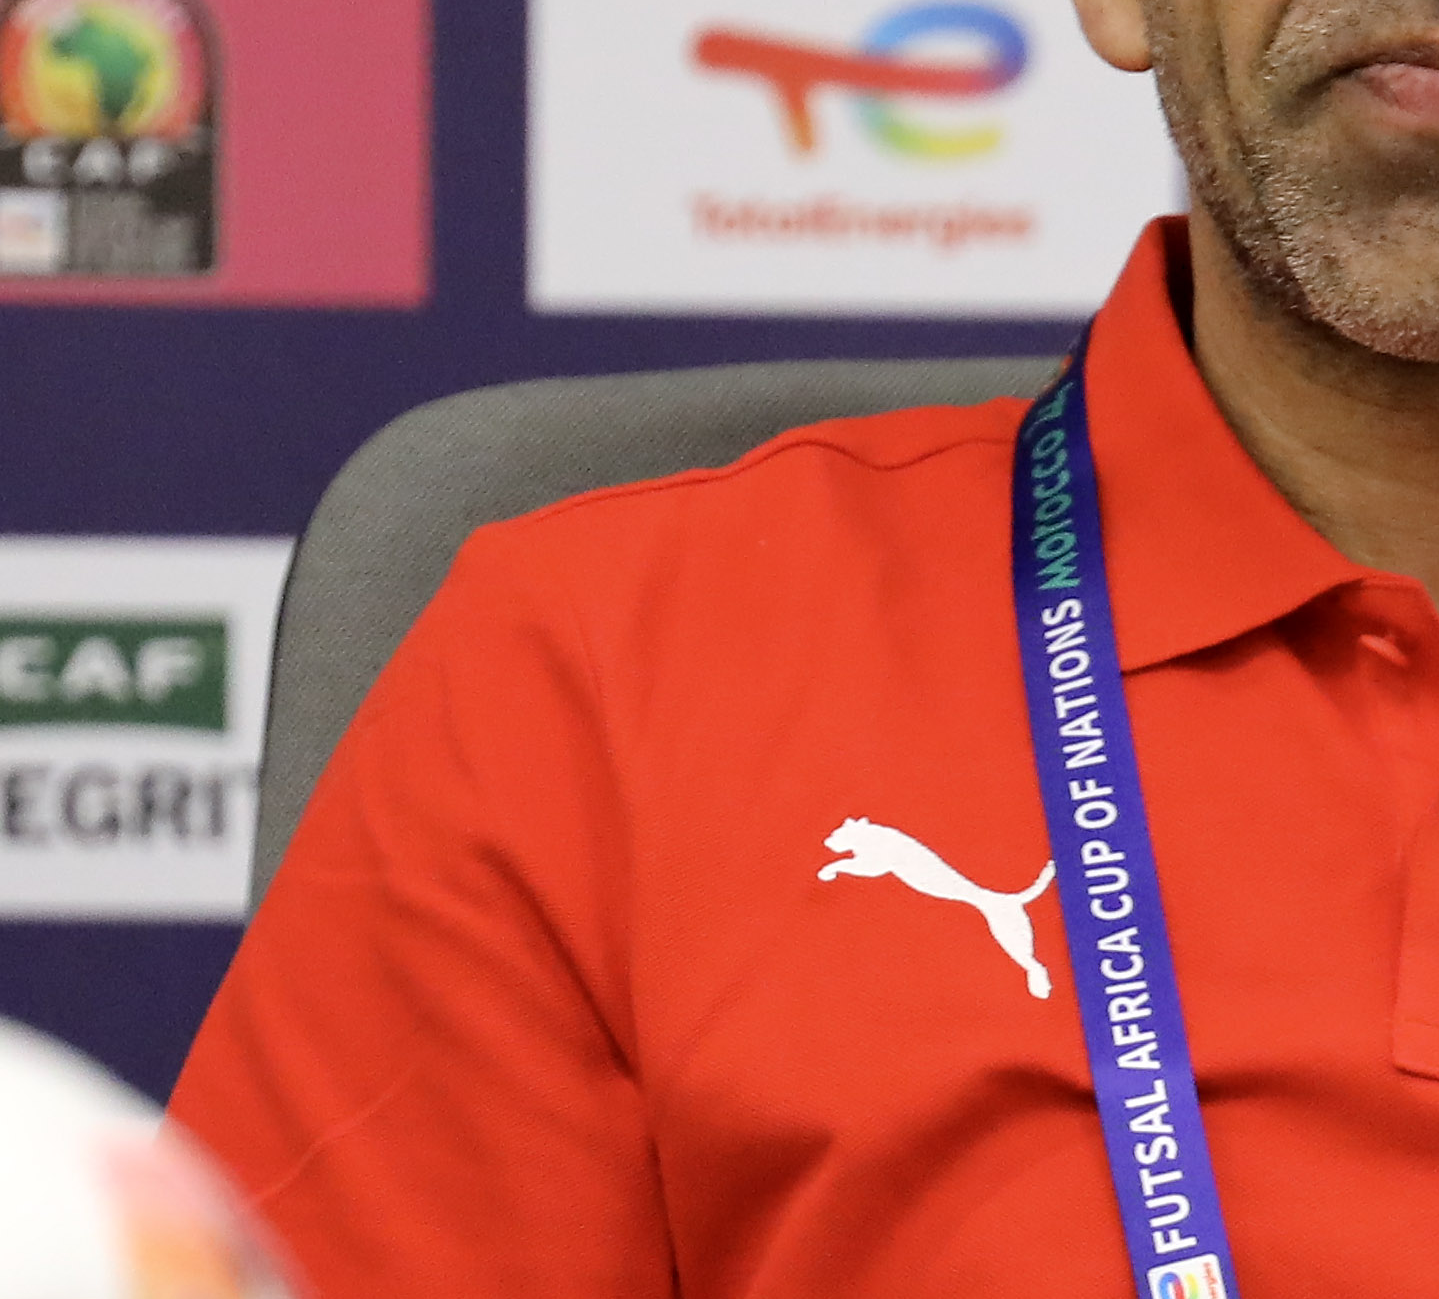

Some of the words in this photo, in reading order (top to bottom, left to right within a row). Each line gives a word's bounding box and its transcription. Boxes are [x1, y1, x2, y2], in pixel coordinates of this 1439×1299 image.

[1042, 598, 1107, 770] NATIONS
[1069, 779, 1119, 830] OF
[1080, 840, 1134, 921] CUP
[1097, 927, 1162, 1070] AFRICA
[1125, 1079, 1198, 1254] FUTSAL
